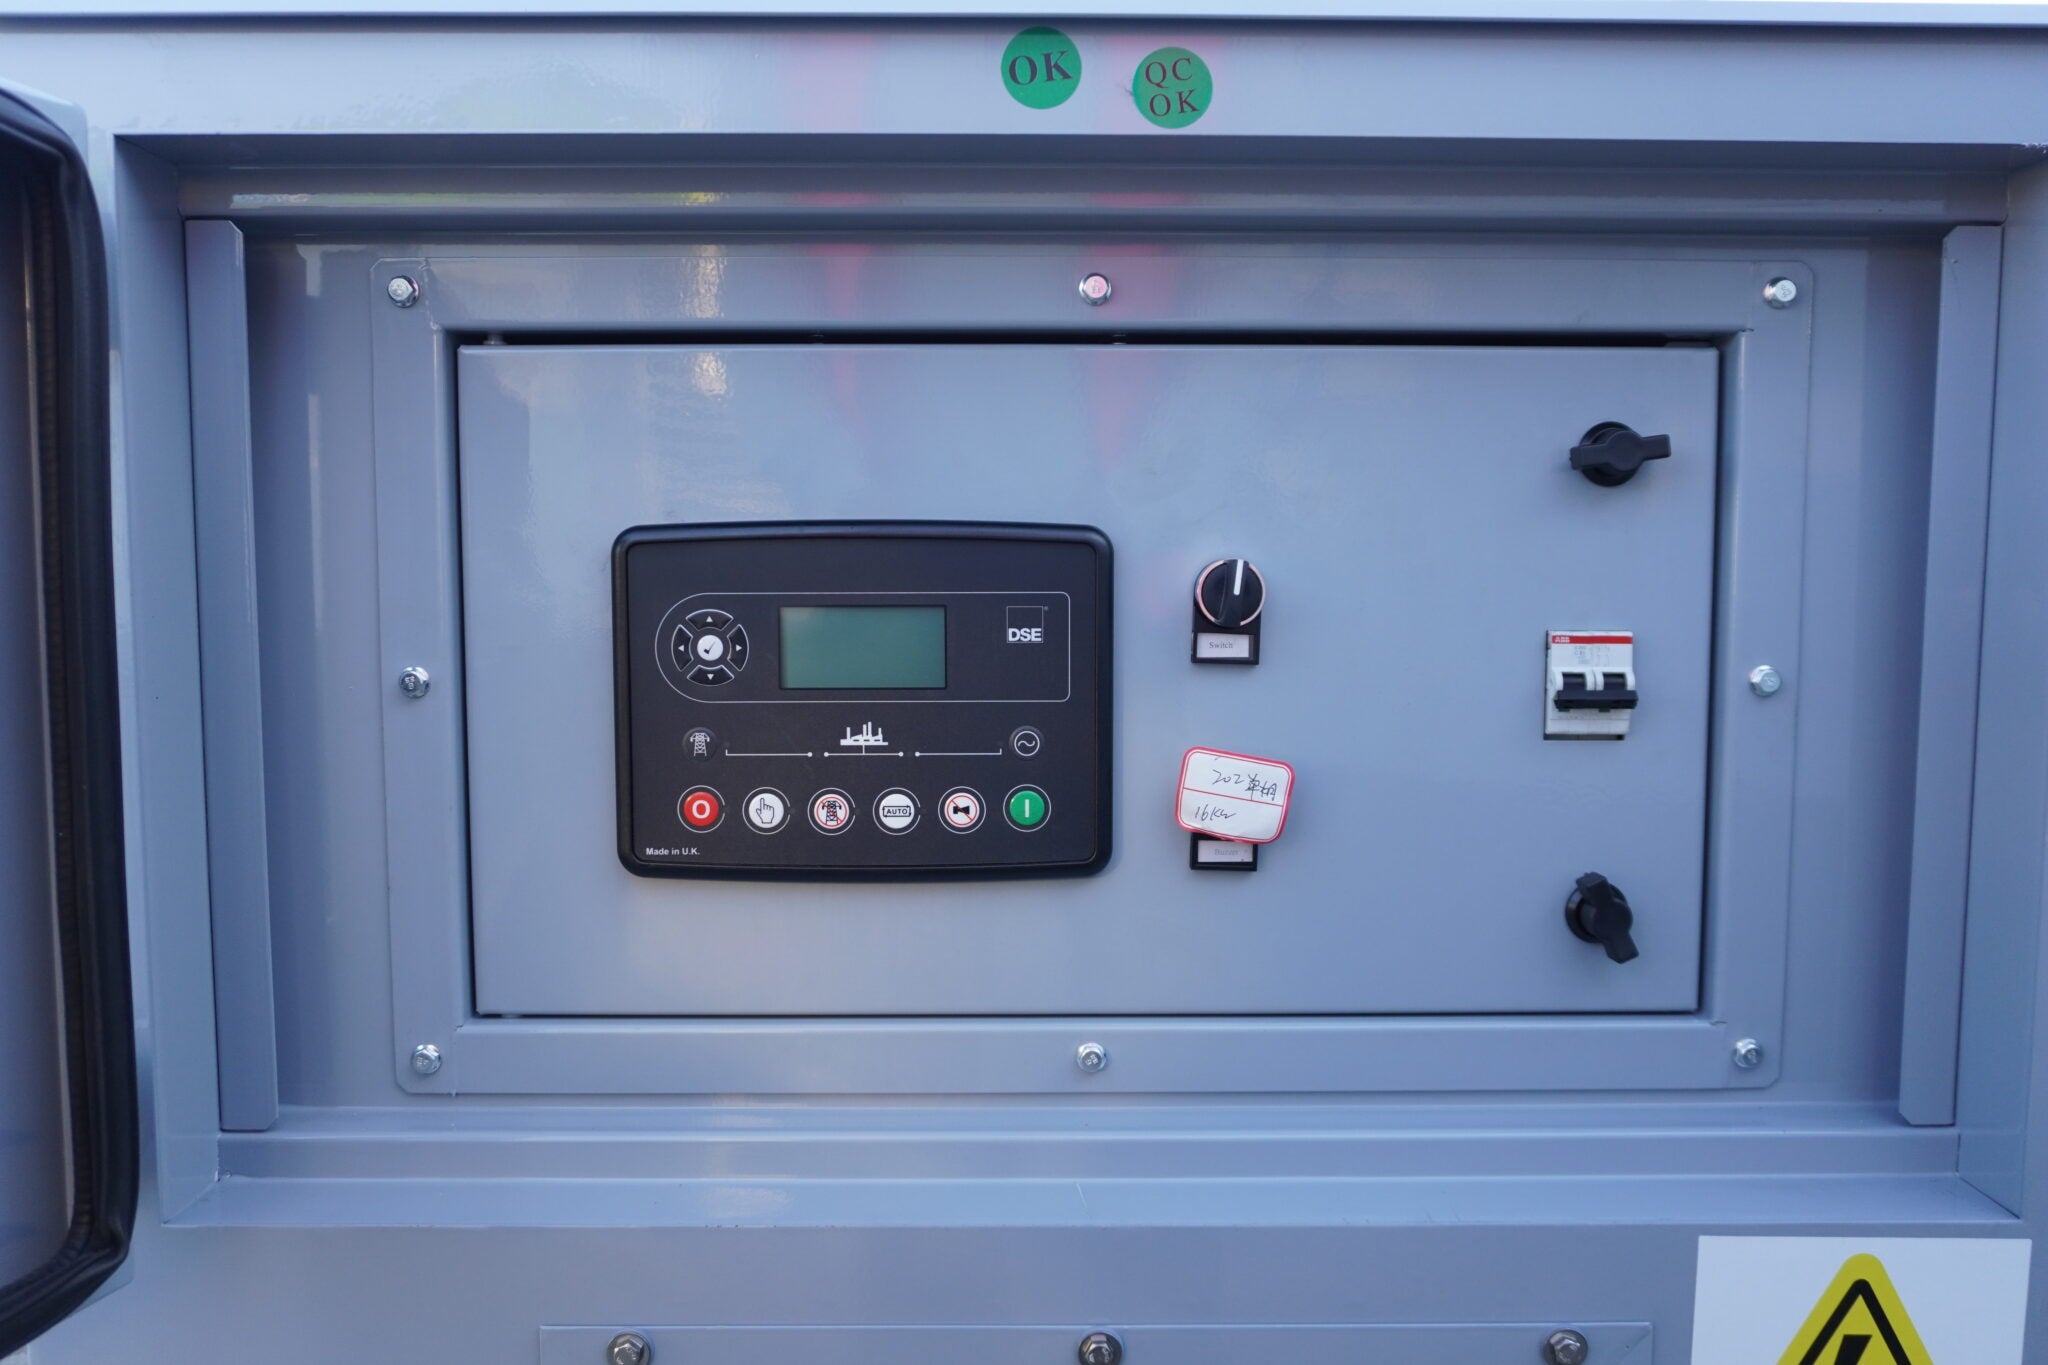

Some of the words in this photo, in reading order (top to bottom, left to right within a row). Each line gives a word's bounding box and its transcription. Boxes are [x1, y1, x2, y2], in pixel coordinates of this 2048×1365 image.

[1008, 50, 1072, 86] OK
[1145, 57, 1193, 89] QC
[1149, 89, 1199, 117] OK
[1008, 627, 1042, 642] DSE
[1208, 640, 1234, 649] Switch
[645, 847, 670, 856] Made
[671, 847, 680, 856] in
[681, 847, 701, 856] U.K.
